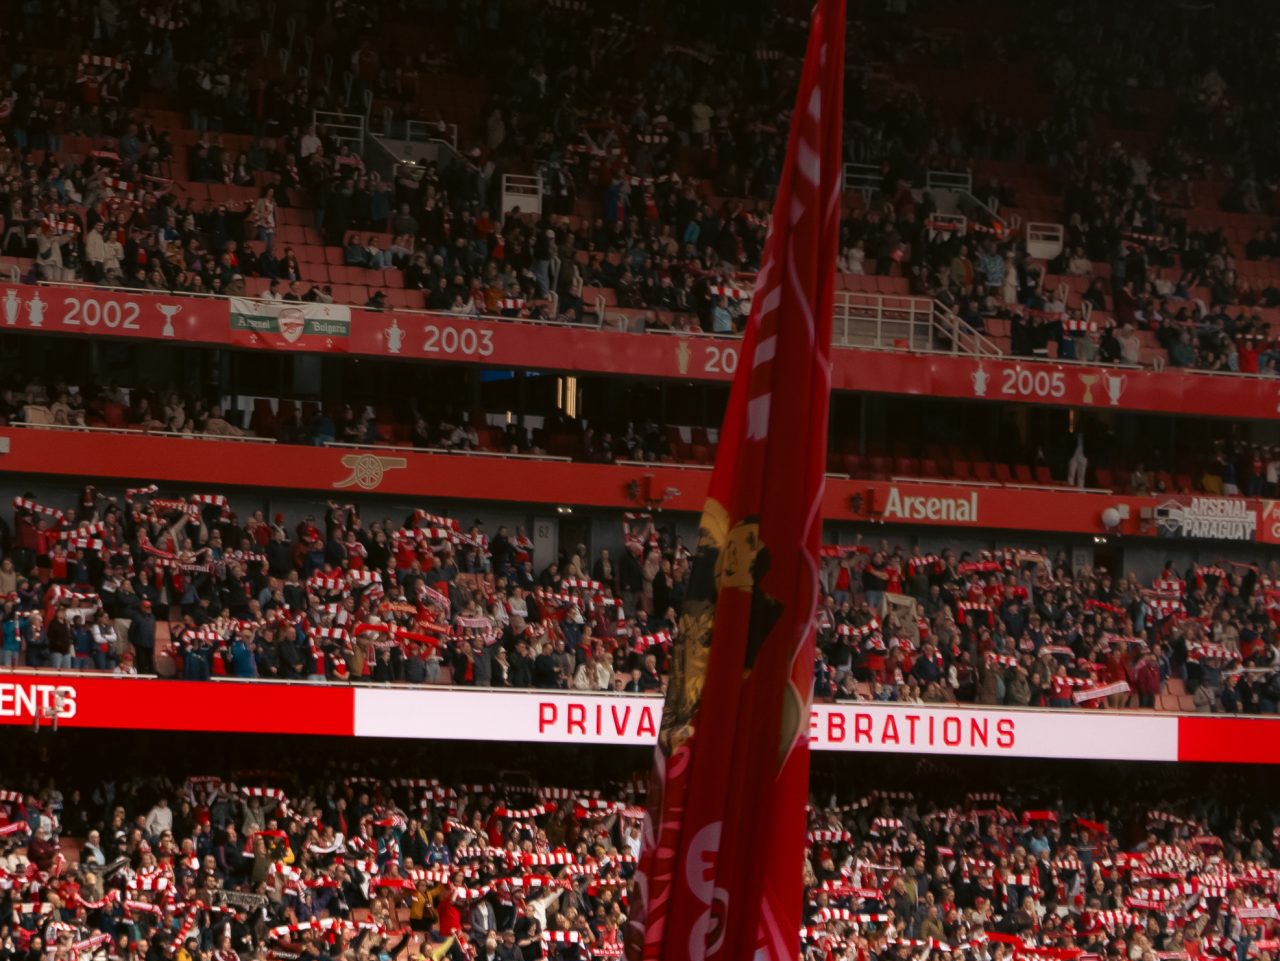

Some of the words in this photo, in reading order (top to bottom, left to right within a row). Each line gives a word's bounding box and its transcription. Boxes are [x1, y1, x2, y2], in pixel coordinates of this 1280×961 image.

[63, 296, 141, 330] 2002
[423, 325, 495, 357] 2003
[703, 346, 738, 374] 20
[1001, 368, 1066, 397] 2005
[883, 487, 979, 523] Arsenal
[1191, 497, 1247, 517] ARSENAL
[1181, 518, 1253, 541] PARAGUAY
[539, 702, 656, 738] PRIVA
[808, 711, 1016, 749] EBRATIONS
